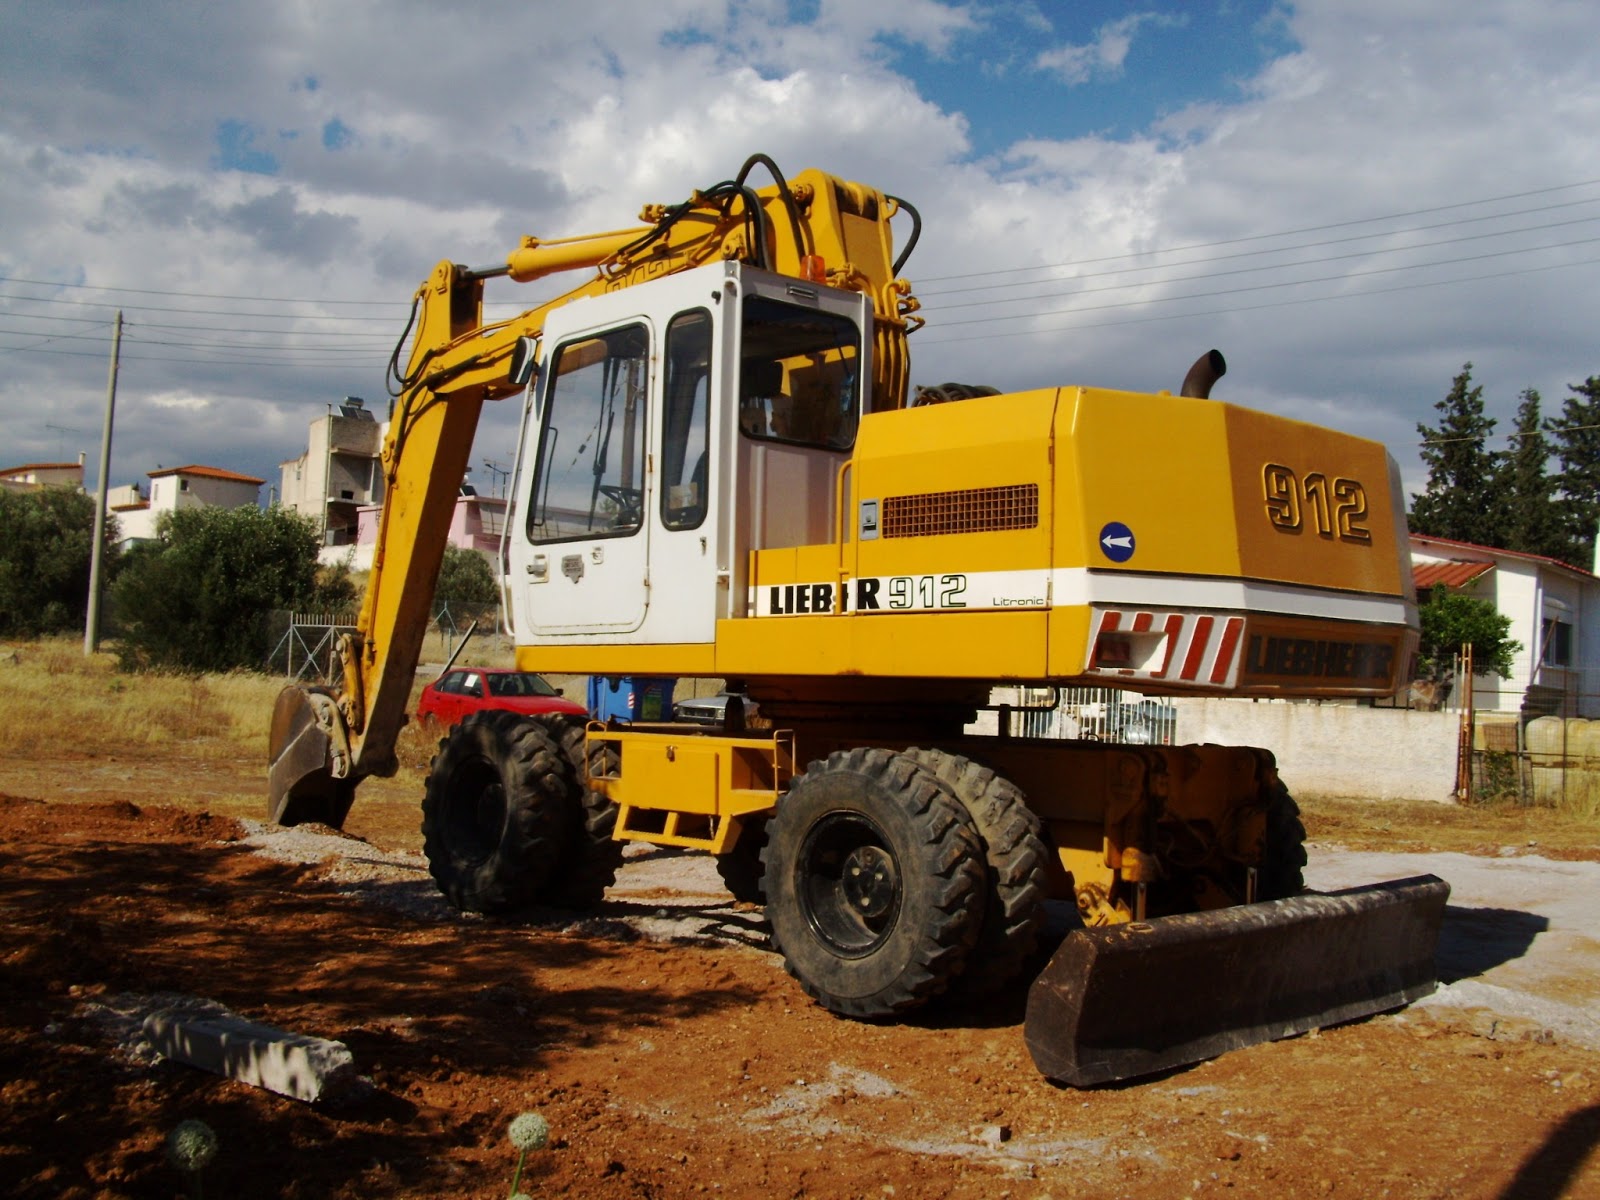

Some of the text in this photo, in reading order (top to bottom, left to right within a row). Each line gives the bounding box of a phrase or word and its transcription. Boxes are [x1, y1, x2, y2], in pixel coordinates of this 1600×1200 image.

[1262, 463, 1372, 540] 912
[889, 574, 967, 609] 912
[992, 595, 1044, 606] Litronic
[1246, 634, 1394, 679] LIEBHERR
